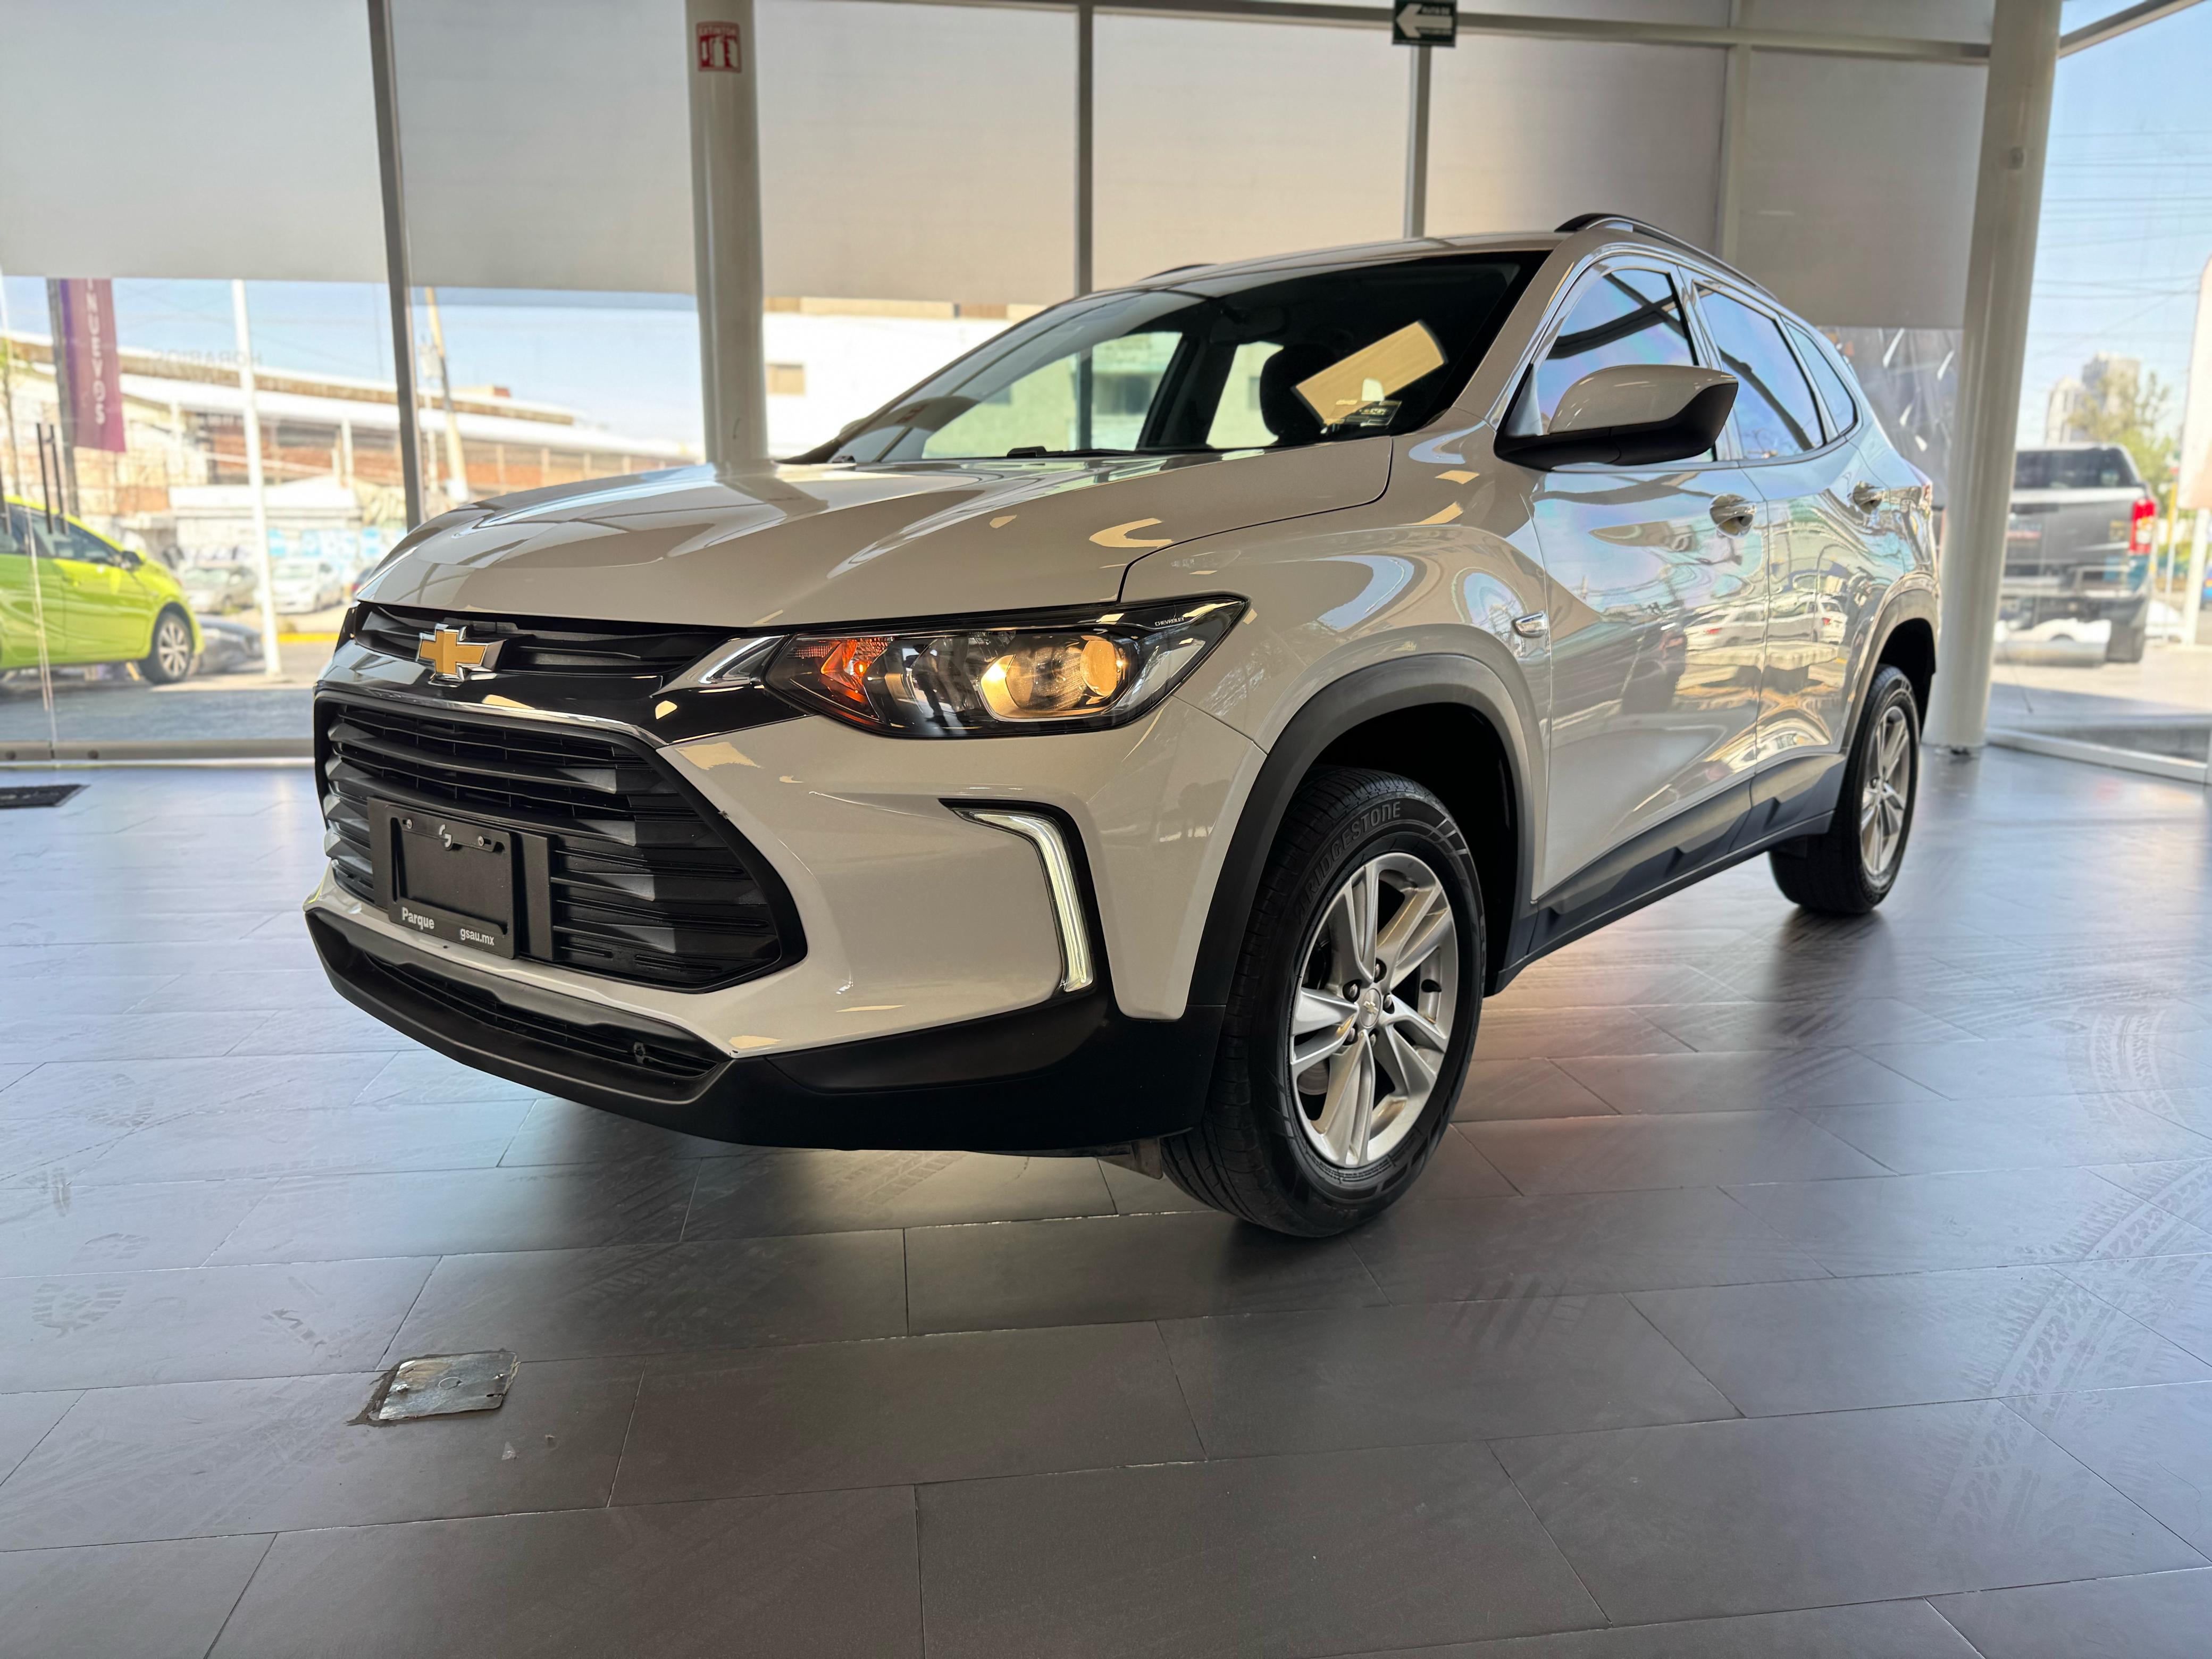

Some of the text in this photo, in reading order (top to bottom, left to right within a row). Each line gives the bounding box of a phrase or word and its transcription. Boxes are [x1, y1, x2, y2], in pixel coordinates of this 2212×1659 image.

[1155, 617, 1185, 626] CHEVROLET
[402, 907, 434, 930] Parque
[460, 927, 495, 945] gsau.mx
